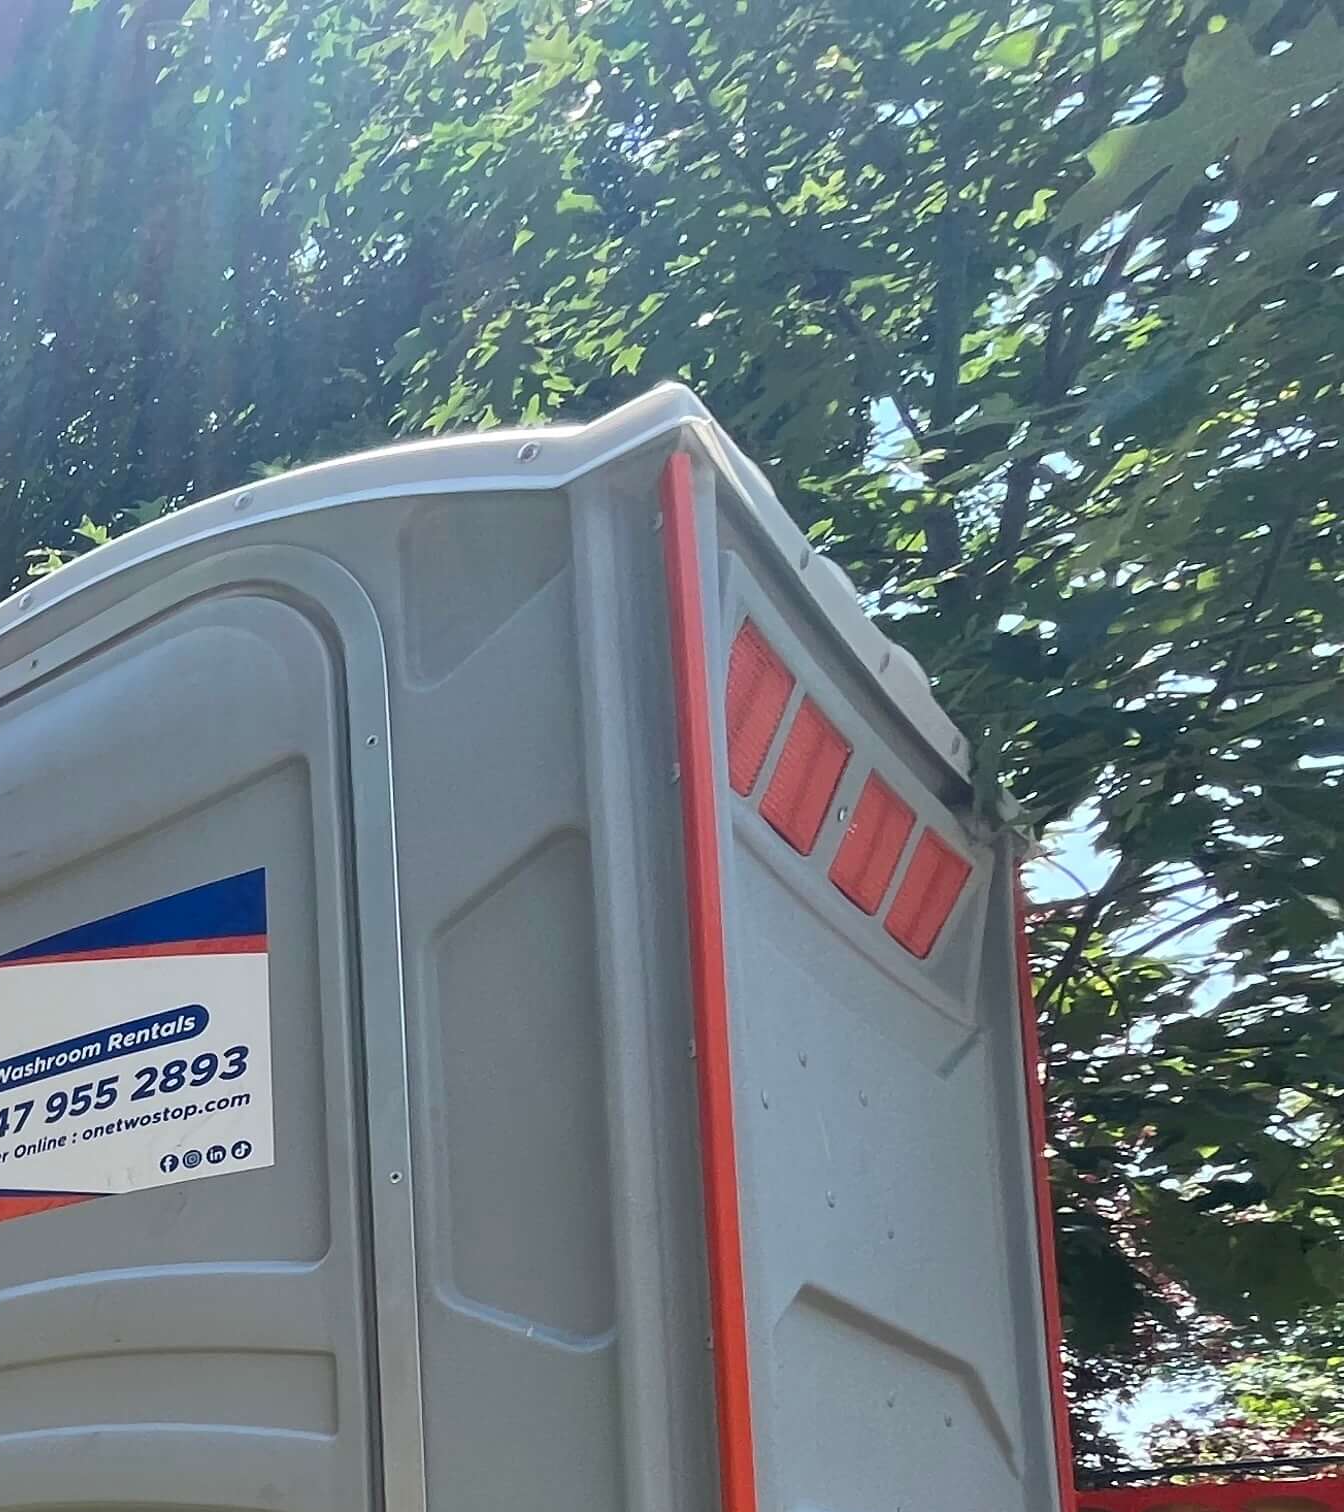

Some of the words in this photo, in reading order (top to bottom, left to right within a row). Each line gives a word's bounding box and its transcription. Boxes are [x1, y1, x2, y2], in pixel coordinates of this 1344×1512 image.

[108, 1015, 196, 1050] Rentals
[44, 1075, 119, 1124] 955
[130, 1045, 249, 1101] 2893
[14, 1135, 67, 1159] Online
[82, 1093, 251, 1141] onetwostop.com
